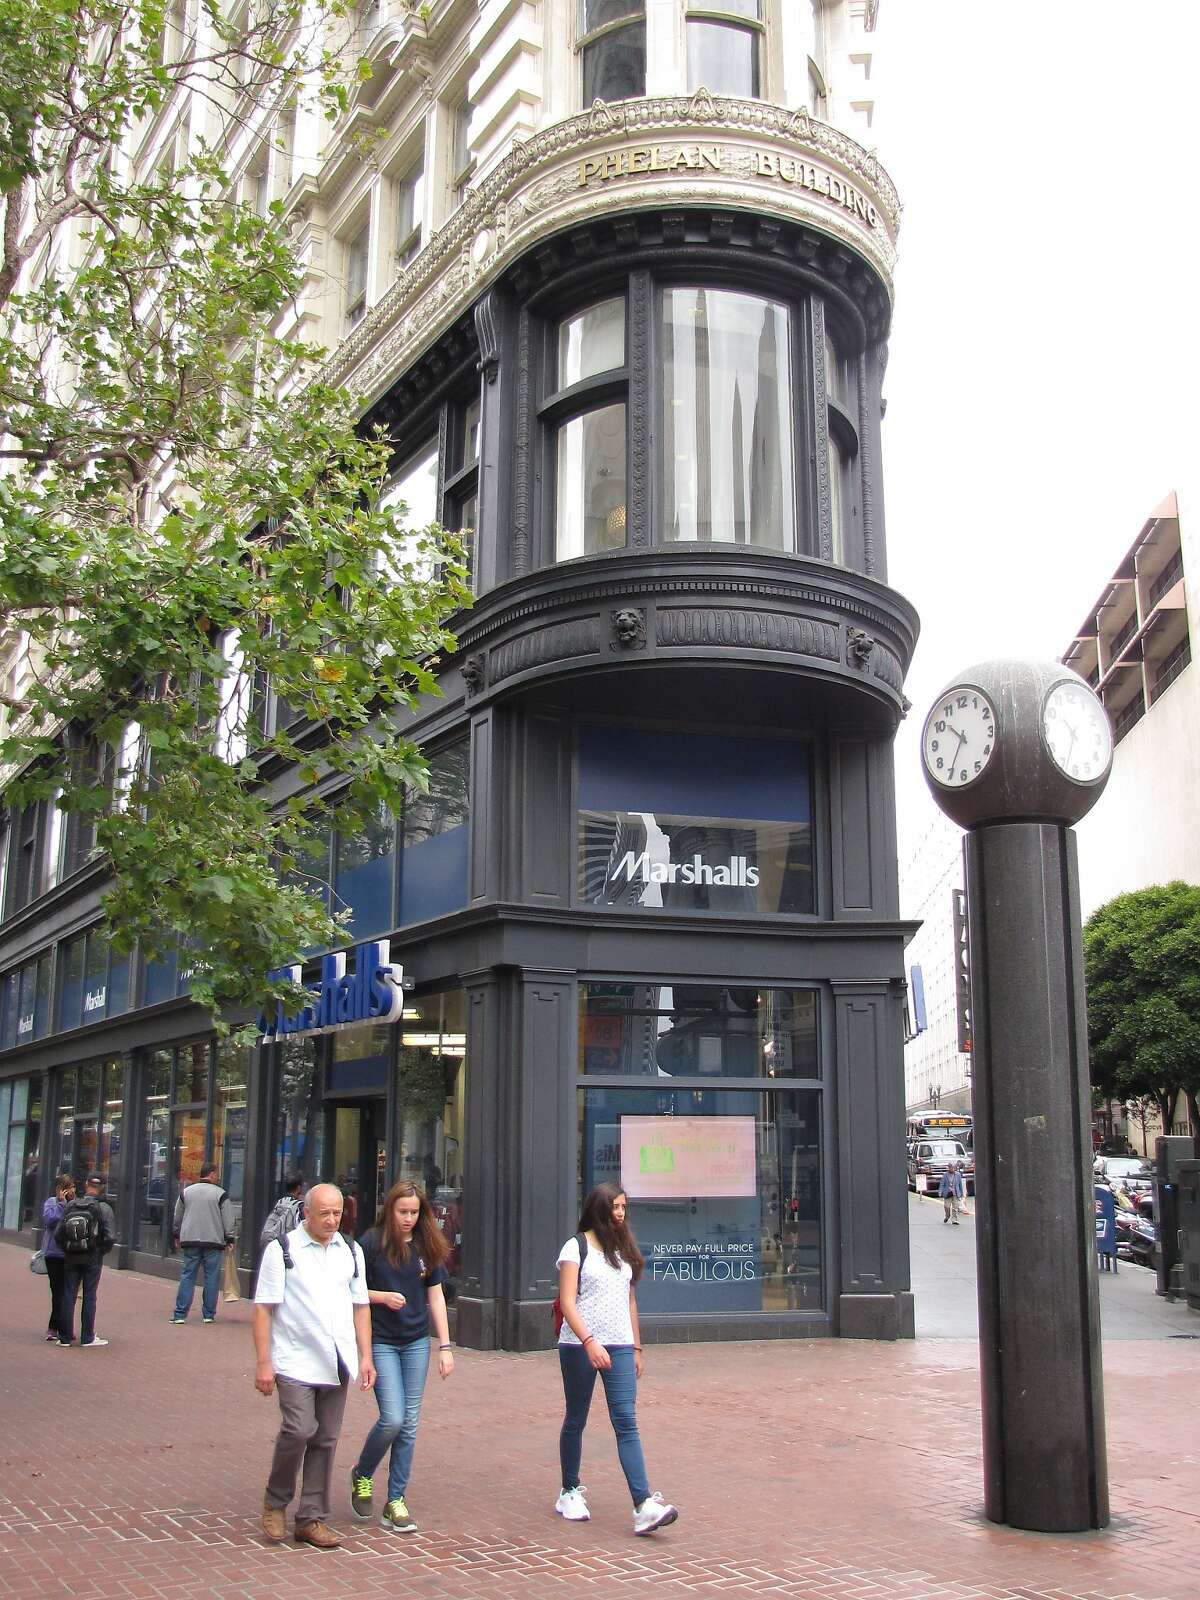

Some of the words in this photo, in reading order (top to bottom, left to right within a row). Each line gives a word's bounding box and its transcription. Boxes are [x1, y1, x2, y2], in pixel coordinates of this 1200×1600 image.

[578, 146, 721, 187] PHELAN
[755, 151, 881, 229] BUILDING
[956, 696, 968, 709] 12
[972, 698, 978, 709] 1
[944, 705, 953, 717] 11
[982, 707, 990, 720] 2
[934, 720, 946, 733] 10
[987, 725, 994, 738] 3
[931, 740, 939, 752] 9
[983, 744, 991, 756] 4
[936, 757, 944, 769] 8
[974, 761, 982, 773] 5
[960, 769, 968, 781] 6
[611, 851, 760, 887] Marshalls
[653, 1243, 683, 1254] NEVER
[685, 1243, 702, 1253] PAY
[705, 1243, 726, 1253] FULL
[728, 1243, 754, 1253] PRICE
[653, 1261, 756, 1281] FABULOUS
